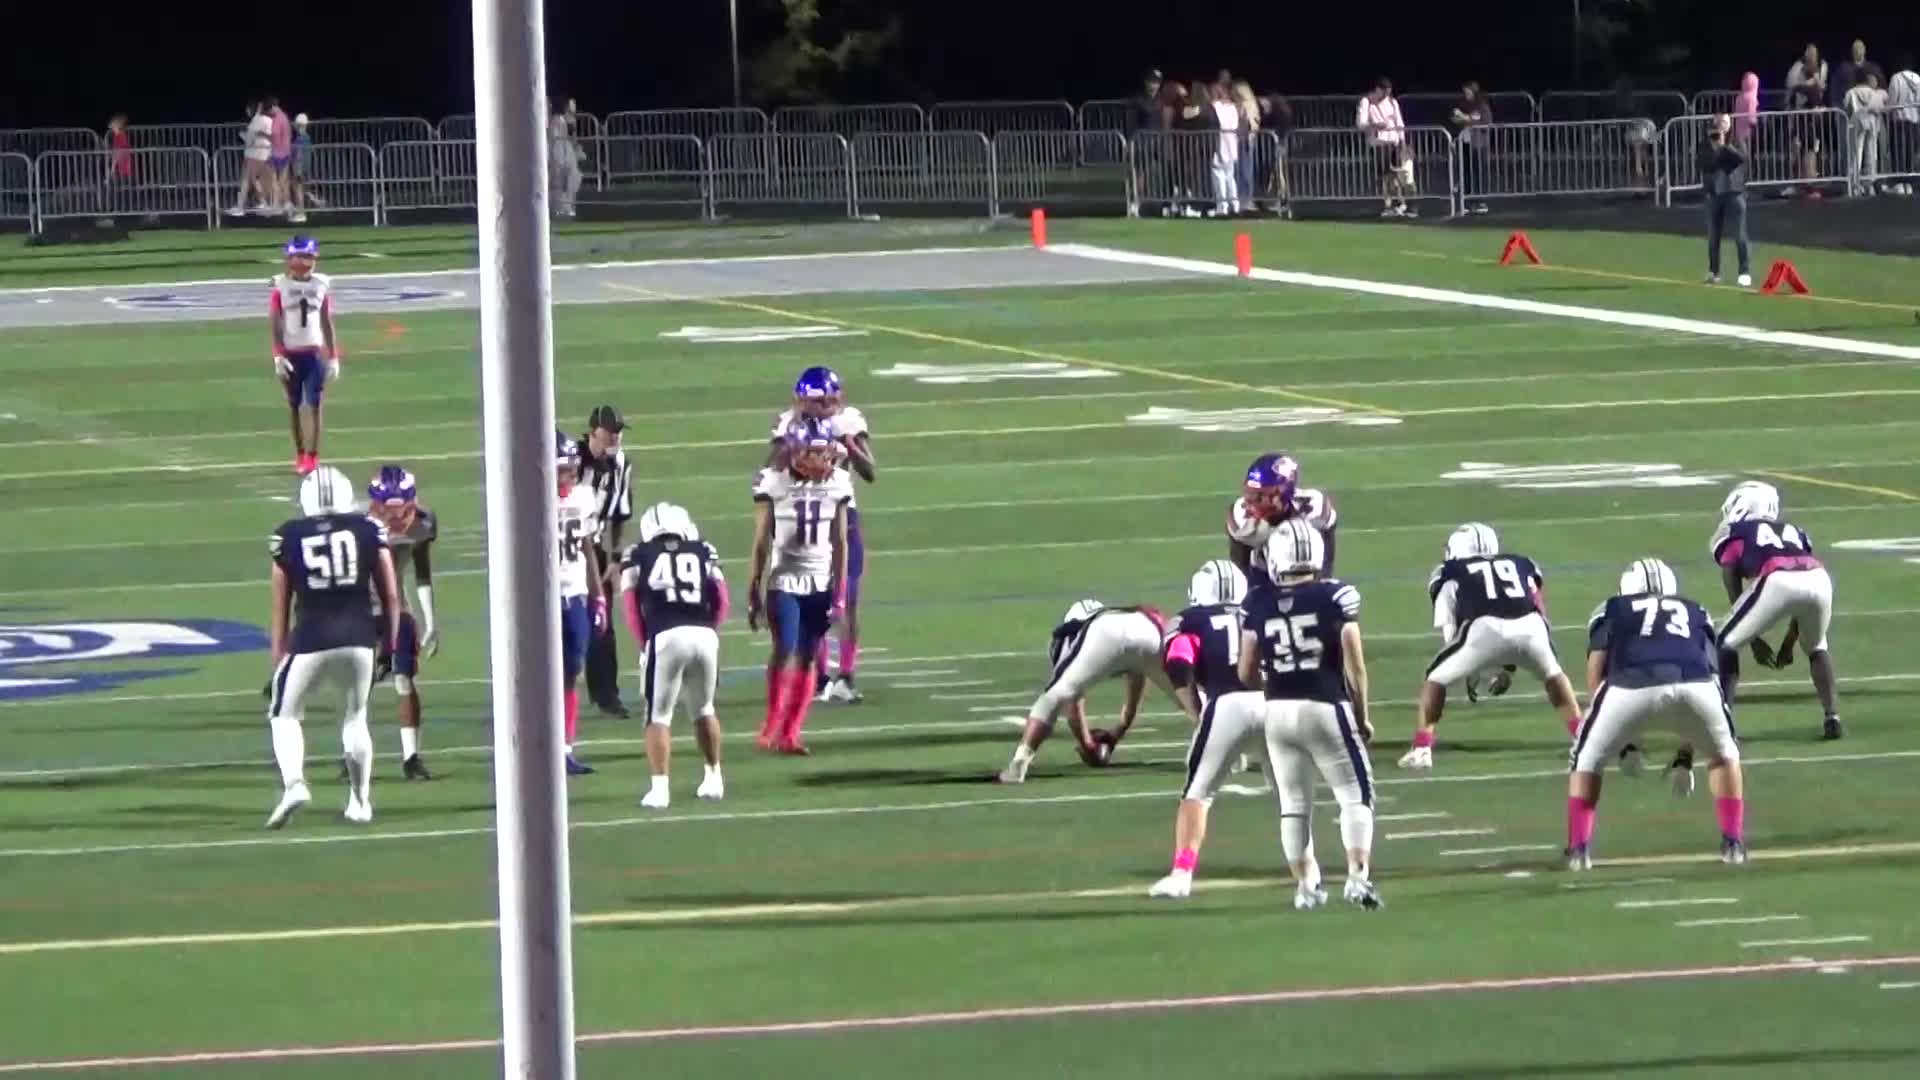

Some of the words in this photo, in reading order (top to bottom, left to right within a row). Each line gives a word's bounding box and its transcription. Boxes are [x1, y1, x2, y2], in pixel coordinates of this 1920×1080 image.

[558, 519, 582, 562] 6
[794, 499, 822, 545] 11
[1756, 522, 1804, 550] 44
[301, 530, 358, 589] 50
[648, 552, 701, 603] 49
[1466, 559, 1525, 600] 79
[1631, 597, 1690, 640] 73
[1264, 612, 1323, 673] 35
